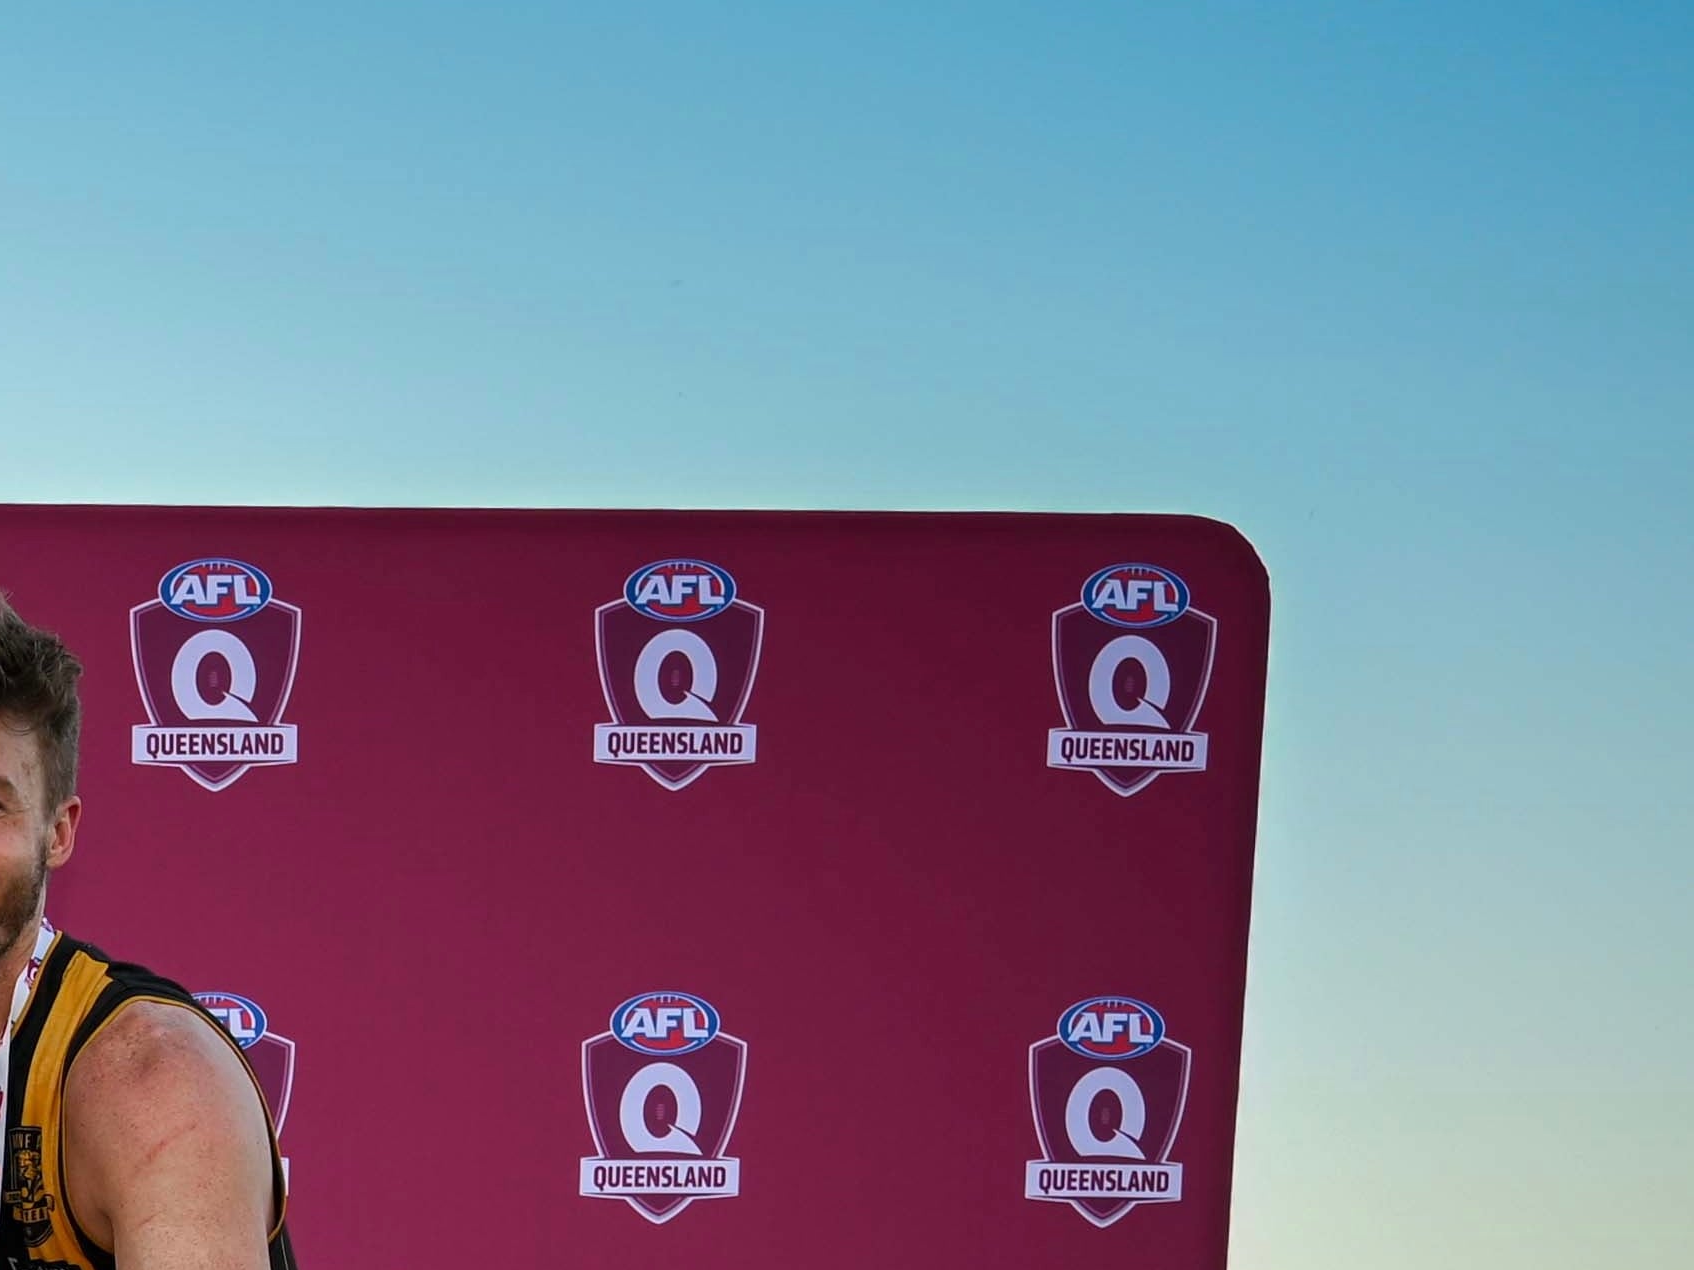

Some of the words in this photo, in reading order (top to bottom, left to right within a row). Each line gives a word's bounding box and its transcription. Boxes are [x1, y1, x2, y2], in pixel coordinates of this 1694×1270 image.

[170, 574, 262, 605] AFL
[635, 575, 726, 606] AFL
[1092, 579, 1180, 612] AFL
[172, 629, 258, 722] Q
[633, 629, 719, 721] Q
[1089, 634, 1169, 728] Q
[146, 733, 285, 758] QUEENSLAND
[607, 731, 744, 757] QUEENSLAND
[1060, 738, 1195, 763] QUEENSLAND
[621, 1008, 712, 1039] AFL
[1069, 1011, 1155, 1043] AFL
[619, 1062, 703, 1155] Q
[1065, 1067, 1145, 1160] Q
[593, 1165, 728, 1191] QUEENSLAND
[1038, 1167, 1171, 1193] QUEENSLAND
